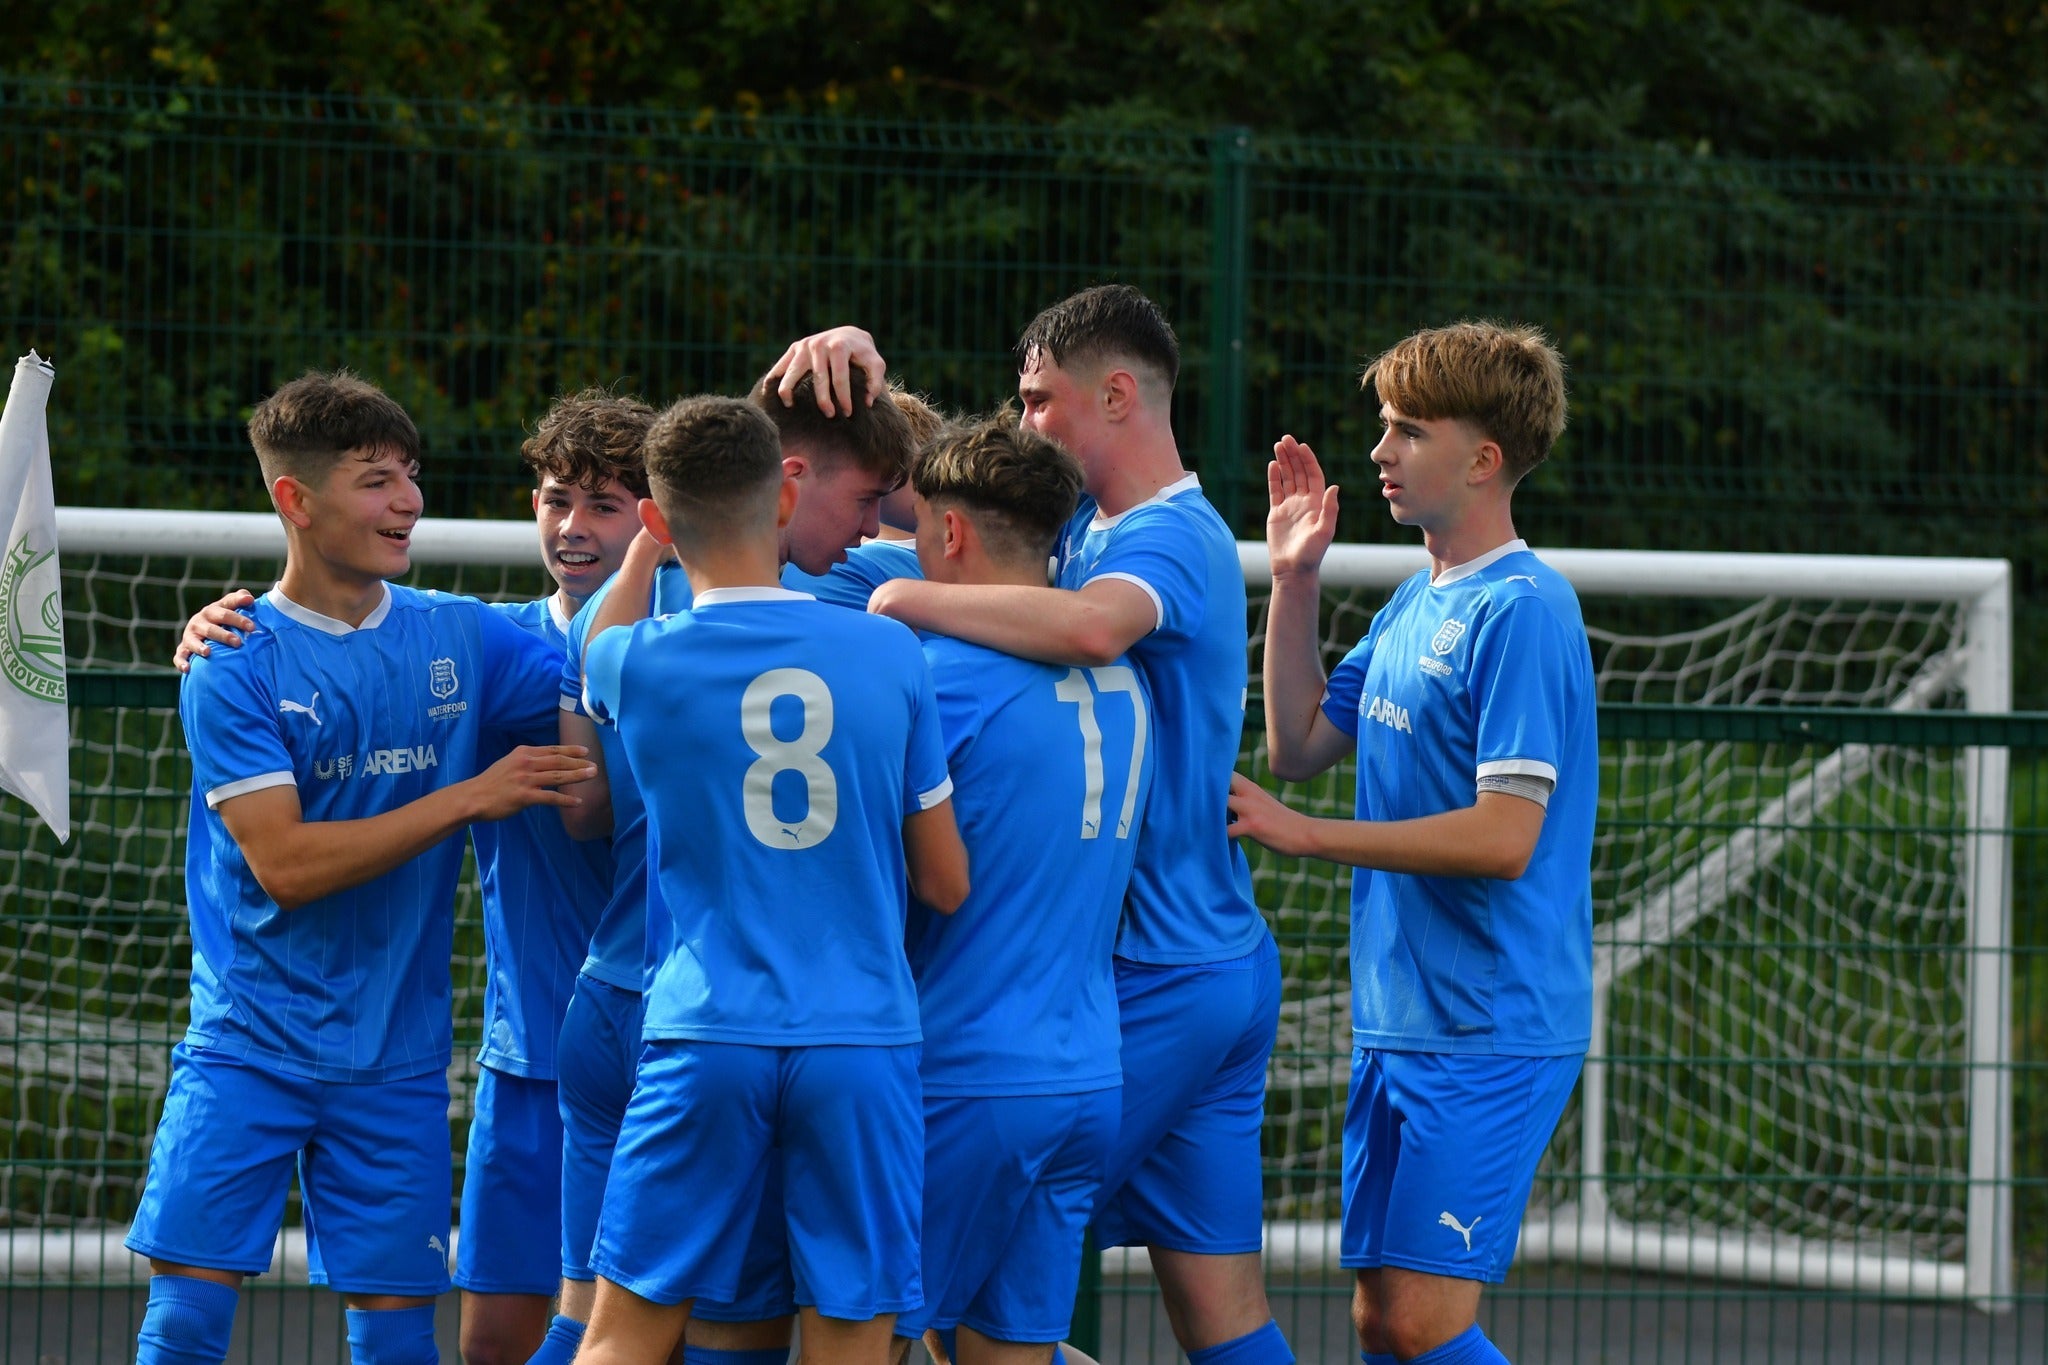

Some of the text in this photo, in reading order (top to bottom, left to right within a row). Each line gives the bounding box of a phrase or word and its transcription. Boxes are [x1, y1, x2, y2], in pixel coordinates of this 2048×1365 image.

[0, 562, 66, 698] SHAMROCK ROVERS
[338, 744, 437, 778] SE ARENA
[428, 701, 467, 718] WATERFORD
[741, 668, 837, 850] 8
[1054, 666, 1146, 839] 17
